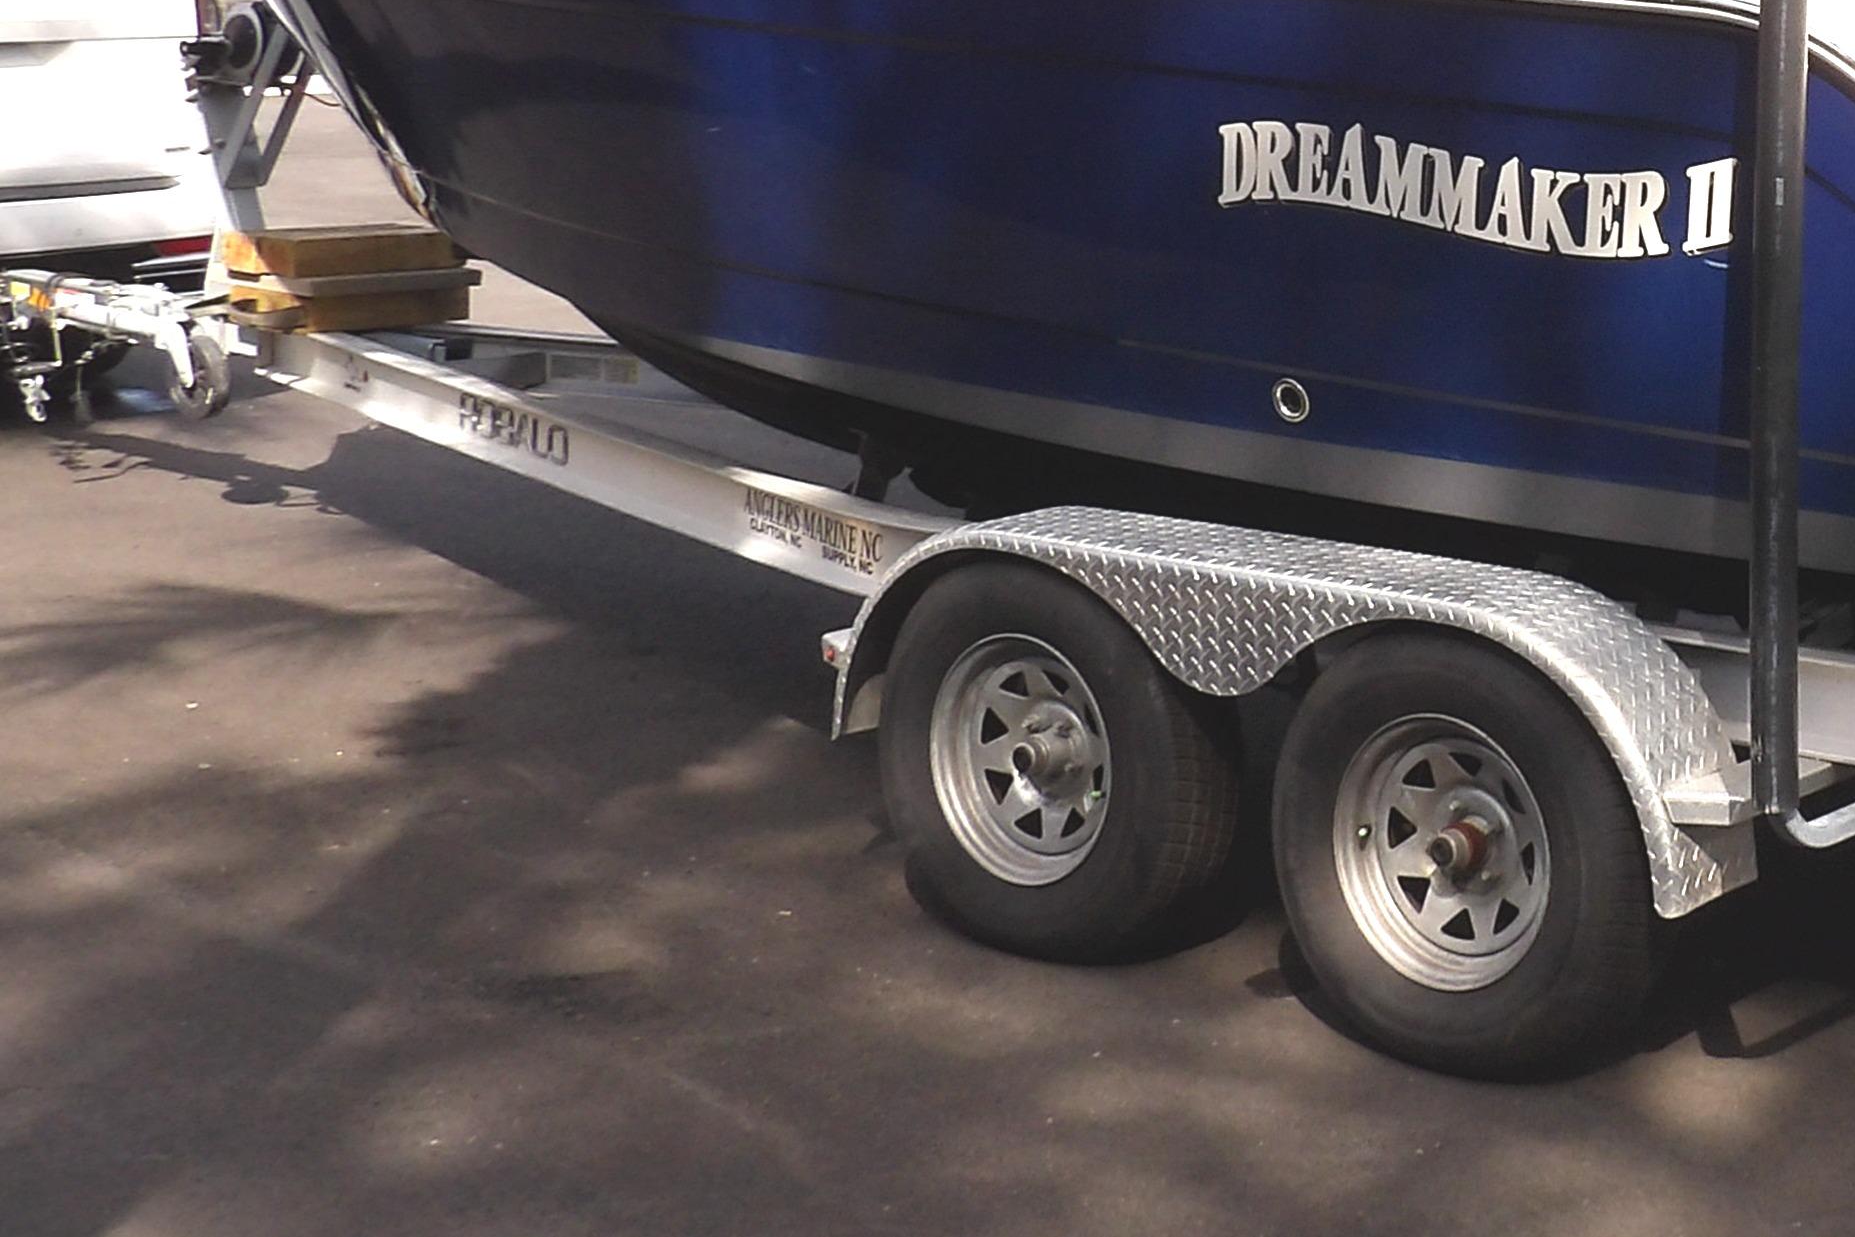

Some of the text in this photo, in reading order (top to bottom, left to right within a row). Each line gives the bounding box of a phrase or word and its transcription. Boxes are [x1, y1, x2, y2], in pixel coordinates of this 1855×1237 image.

[1218, 120, 1739, 258] DREAMMAKER II
[744, 487, 883, 563] ANGLERS MARINE NC
[859, 560, 874, 575] NC
